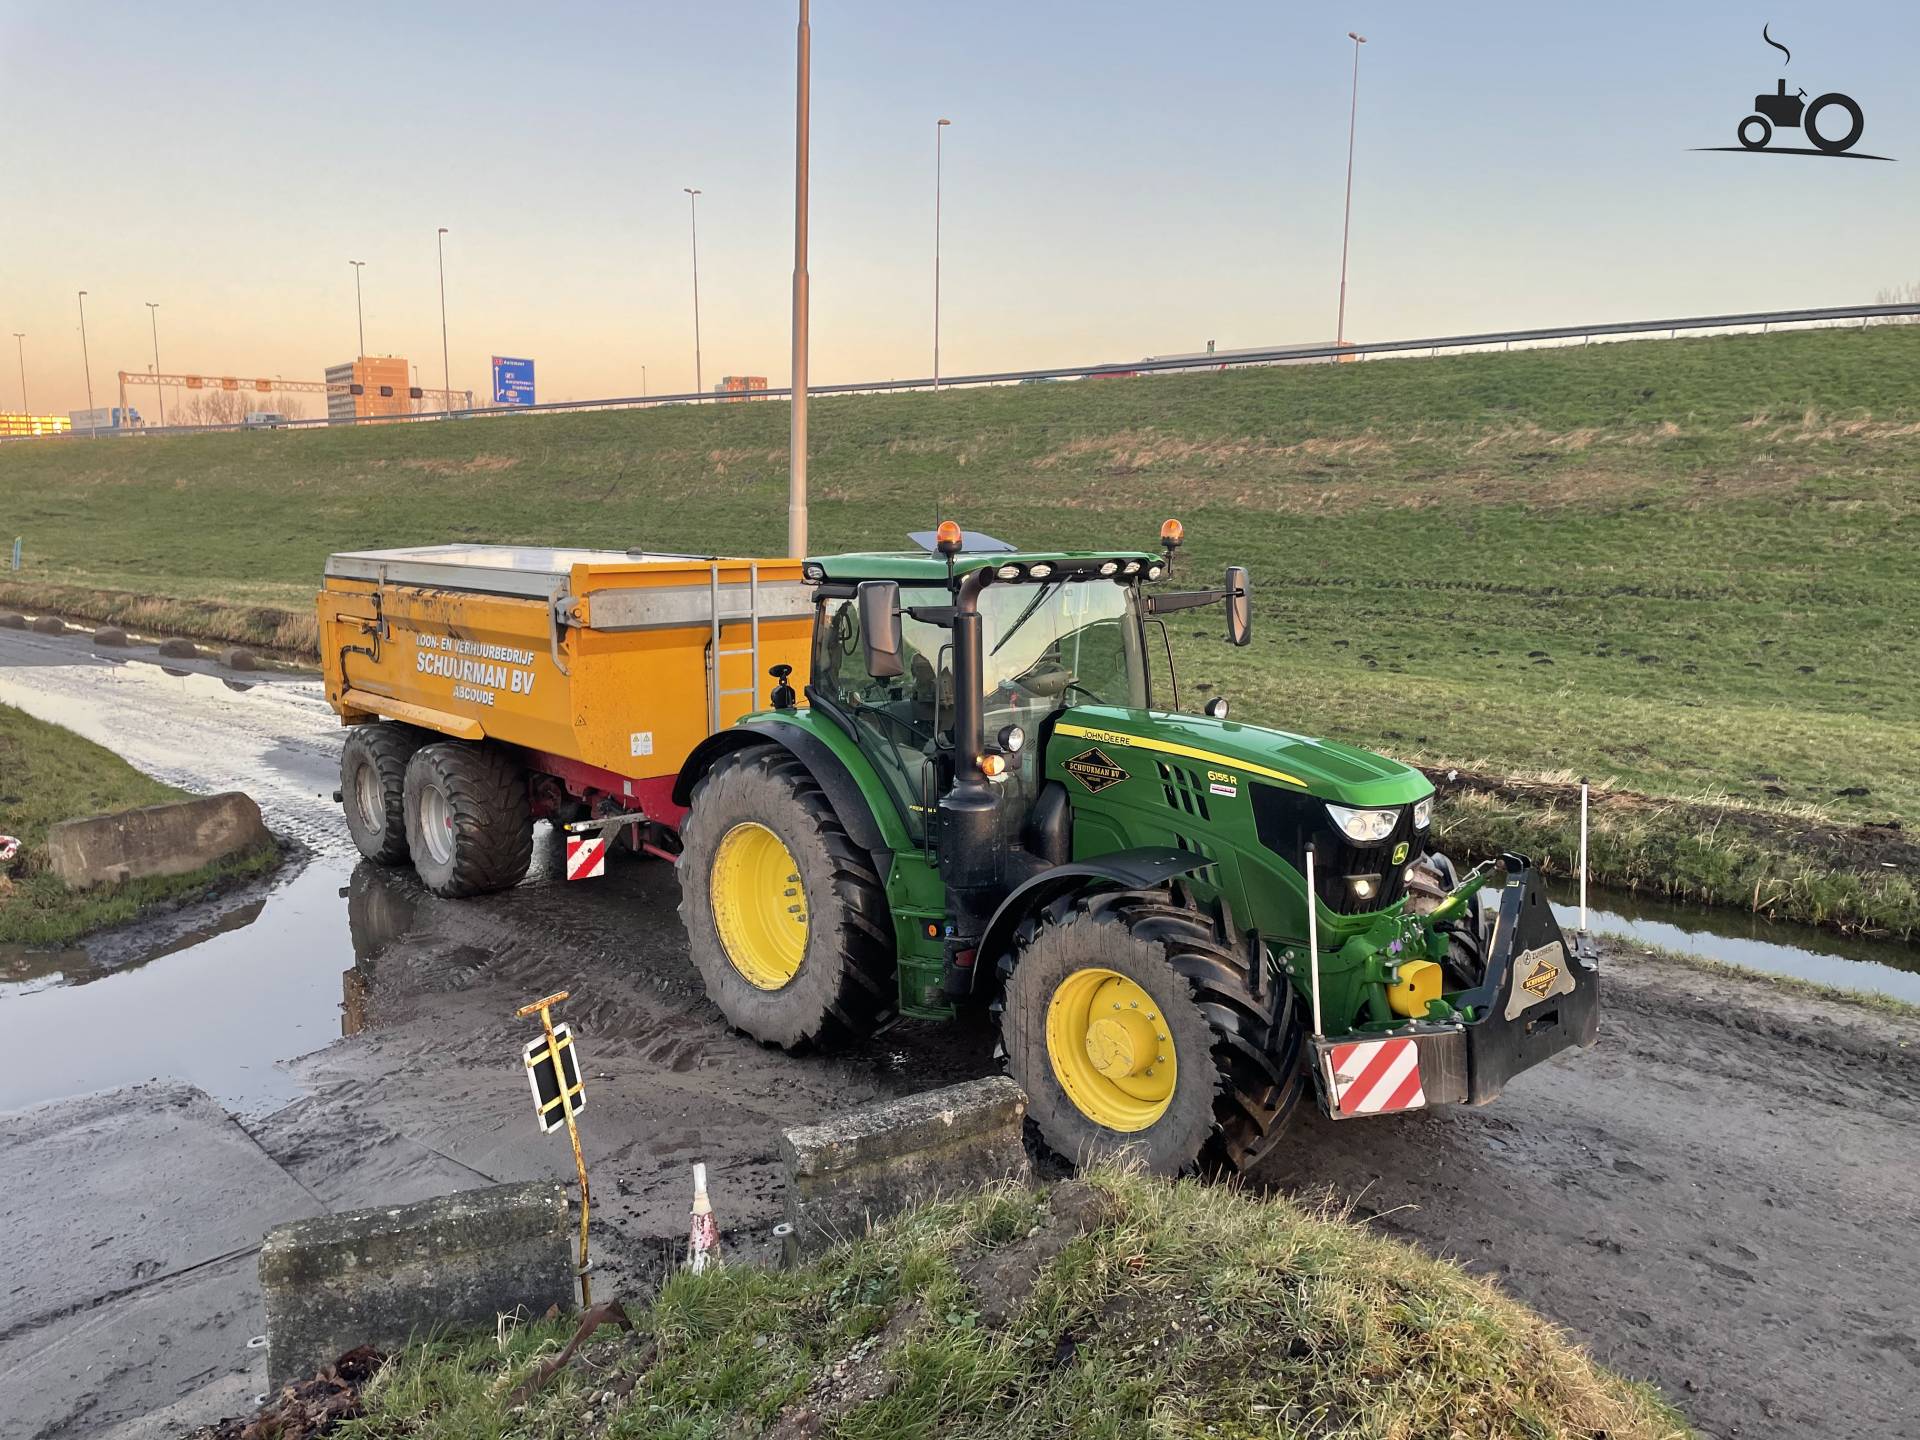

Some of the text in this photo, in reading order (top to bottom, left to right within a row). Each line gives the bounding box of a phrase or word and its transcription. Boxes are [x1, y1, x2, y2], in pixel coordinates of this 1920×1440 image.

[441, 637, 452, 651] EN
[455, 640, 535, 666] VERHUURBEDRIJF
[416, 651, 535, 695] SCHUURMAN BV
[453, 685, 495, 706] ABCOUDE
[1069, 762, 1120, 778] SCHUURMAN BV
